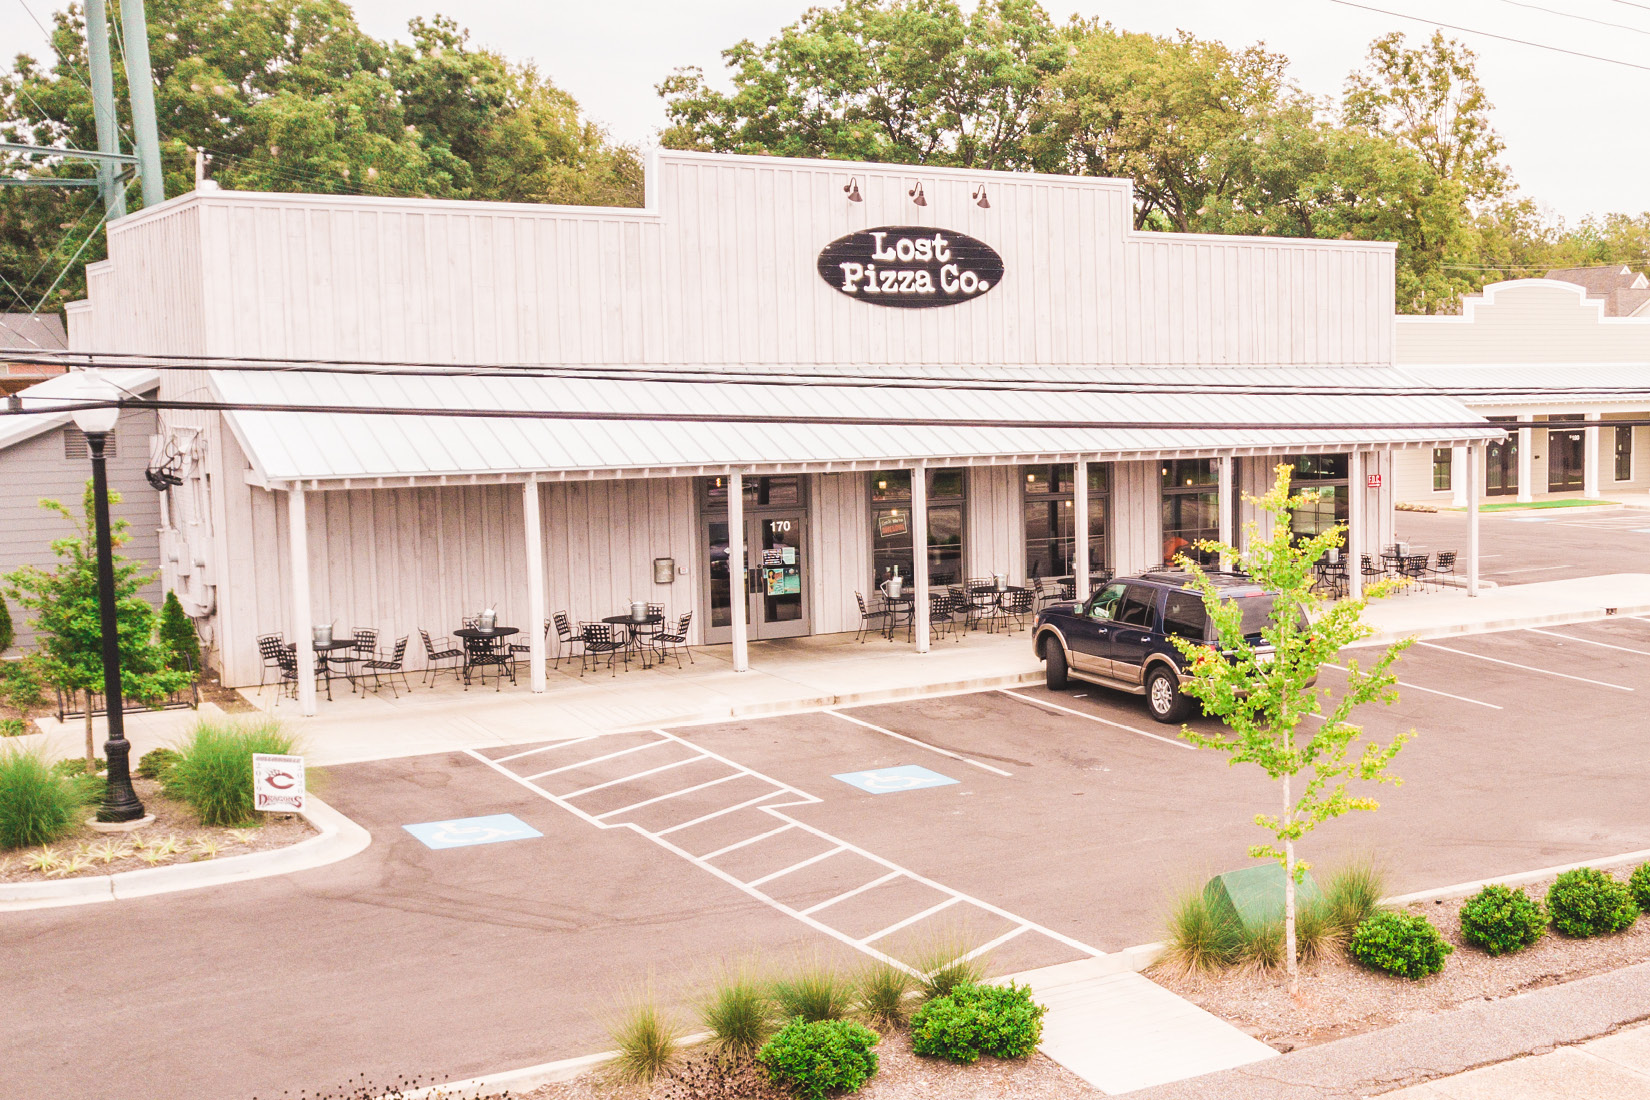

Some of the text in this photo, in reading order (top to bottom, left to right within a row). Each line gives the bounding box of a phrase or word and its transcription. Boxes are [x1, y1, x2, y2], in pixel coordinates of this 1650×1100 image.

[869, 231, 951, 263] Lost
[839, 261, 990, 294] Pizza Co.
[770, 520, 791, 532] 170
